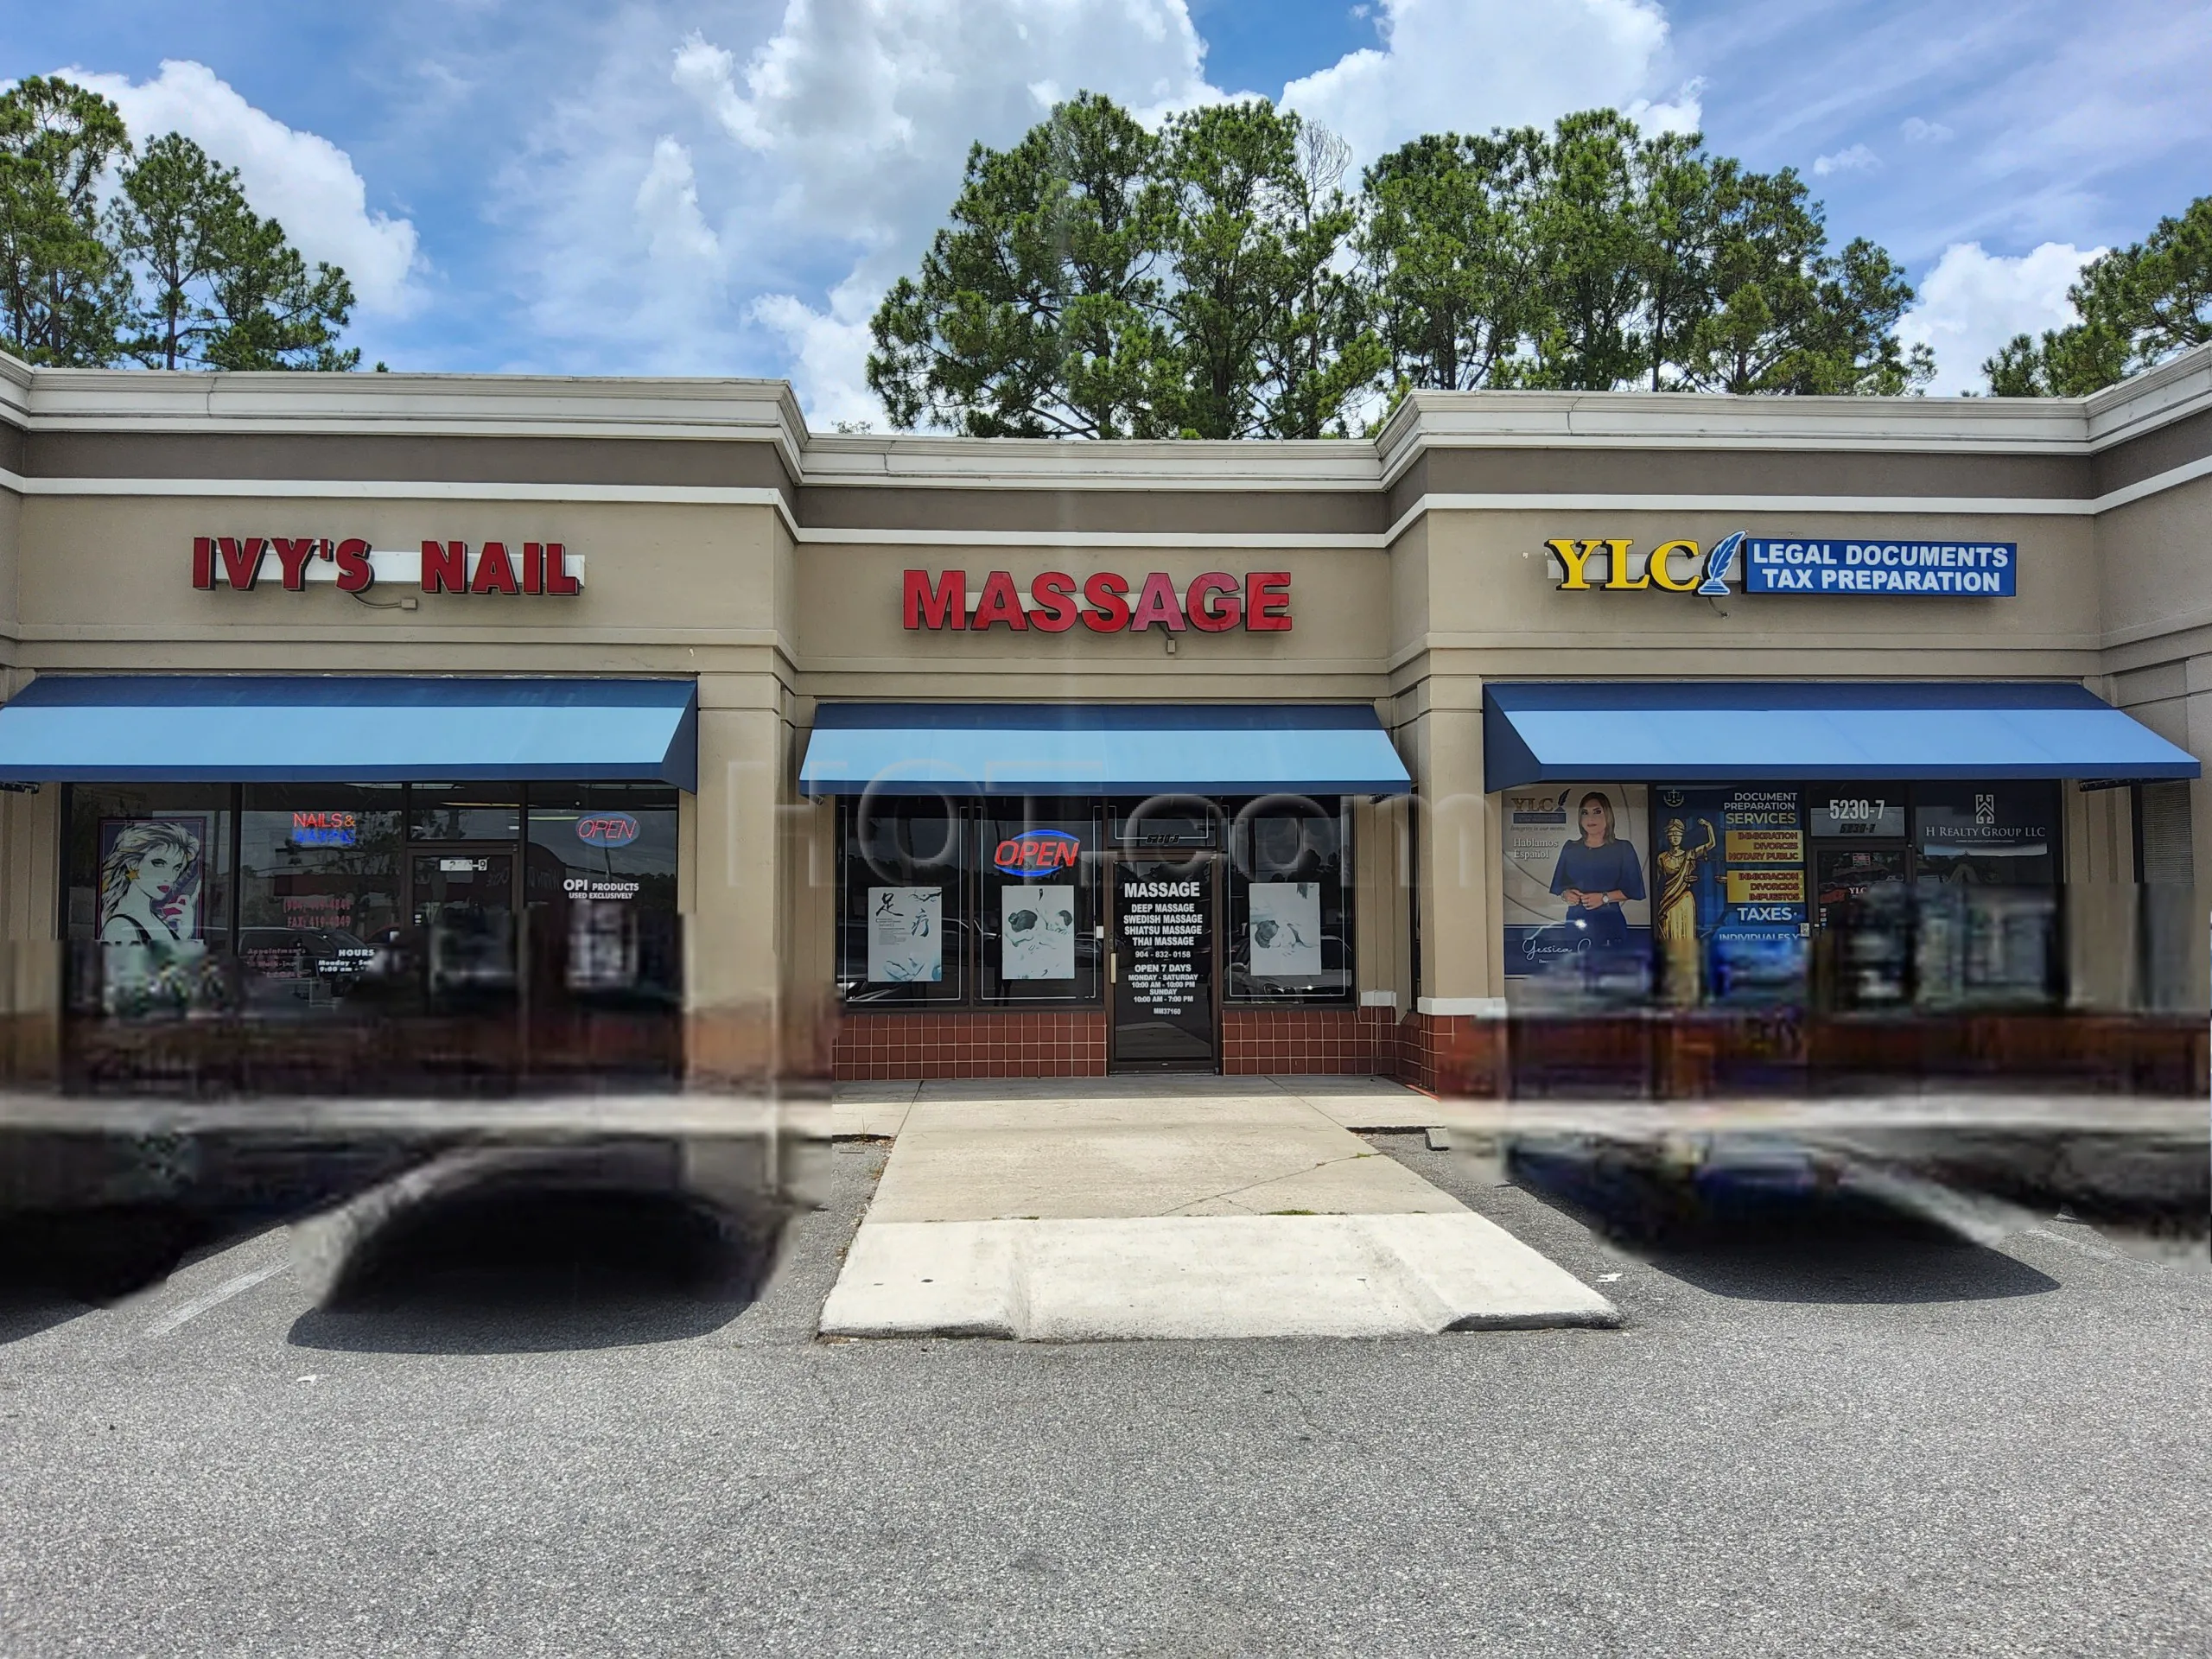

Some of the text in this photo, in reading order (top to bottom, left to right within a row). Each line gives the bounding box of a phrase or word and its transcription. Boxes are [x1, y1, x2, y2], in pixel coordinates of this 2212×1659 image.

[1753, 543, 2008, 567] LEGAL DOCUMENTS
[193, 537, 581, 594] IVY'S NAIL
[1548, 538, 1700, 591] YLC
[1762, 569, 1999, 591] TAX PREPARATION
[903, 569, 1292, 632] MASSAGE
[1734, 792, 1798, 801] DOCUMENT
[1511, 798, 1554, 811] YLC
[1724, 802, 1795, 810] PREPARATION
[1829, 799, 1885, 820] 5230-7
[1726, 812, 1796, 824] SERVICES
[577, 819, 638, 839] OPEN
[1926, 826, 2046, 836] H REALTY GROUP LLC
[1514, 837, 1559, 848] Hablamos
[995, 840, 1079, 867] OPEN
[1514, 849, 1549, 860] Español
[1728, 852, 1799, 861] NOTARY PUBLIC
[563, 879, 588, 891] OPI
[592, 882, 639, 892] PRODUCTS
[1124, 882, 1200, 898] MASSAGE
[1131, 903, 1195, 913] DEEP MASSAGE
[1737, 907, 1792, 921] TAXES
[1123, 914, 1203, 924] SWEDISH MASSAGE
[1124, 925, 1203, 935] SHIATSU MASSAGE
[1132, 937, 1194, 946] THAI MASSAGE
[1135, 964, 1160, 973] OPEN
[1160, 964, 1167, 973] 7
